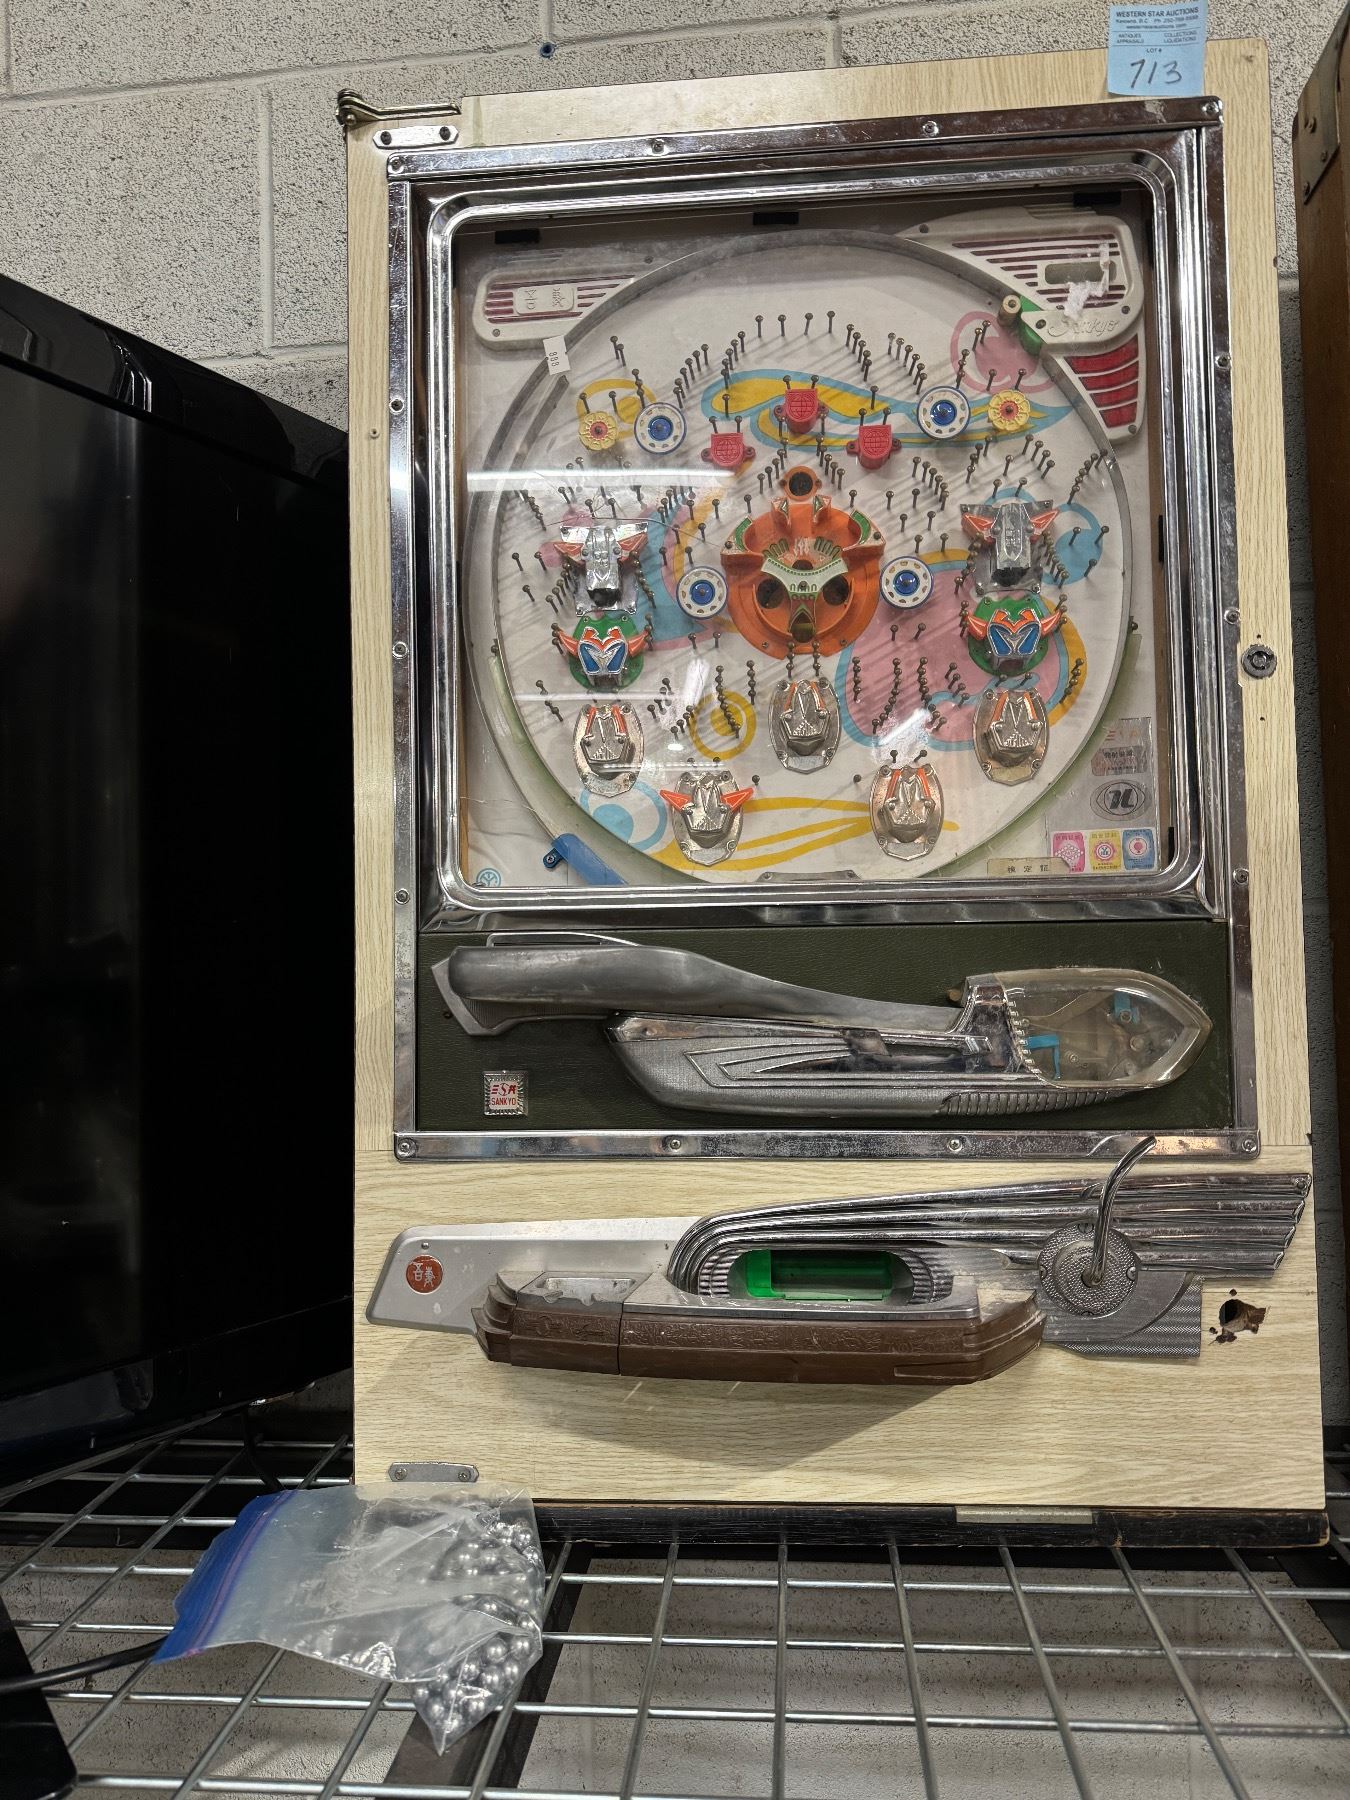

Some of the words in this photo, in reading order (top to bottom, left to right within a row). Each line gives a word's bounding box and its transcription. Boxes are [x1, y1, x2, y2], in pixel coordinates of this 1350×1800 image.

[1116, 10, 1146, 18] WESTERN
[1166, 6, 1199, 16] AUCTIONS
[1164, 30, 1198, 38] COLLECTIONS
[1130, 58, 1183, 89] 713
[491, 1097, 517, 1106] SANKYO
